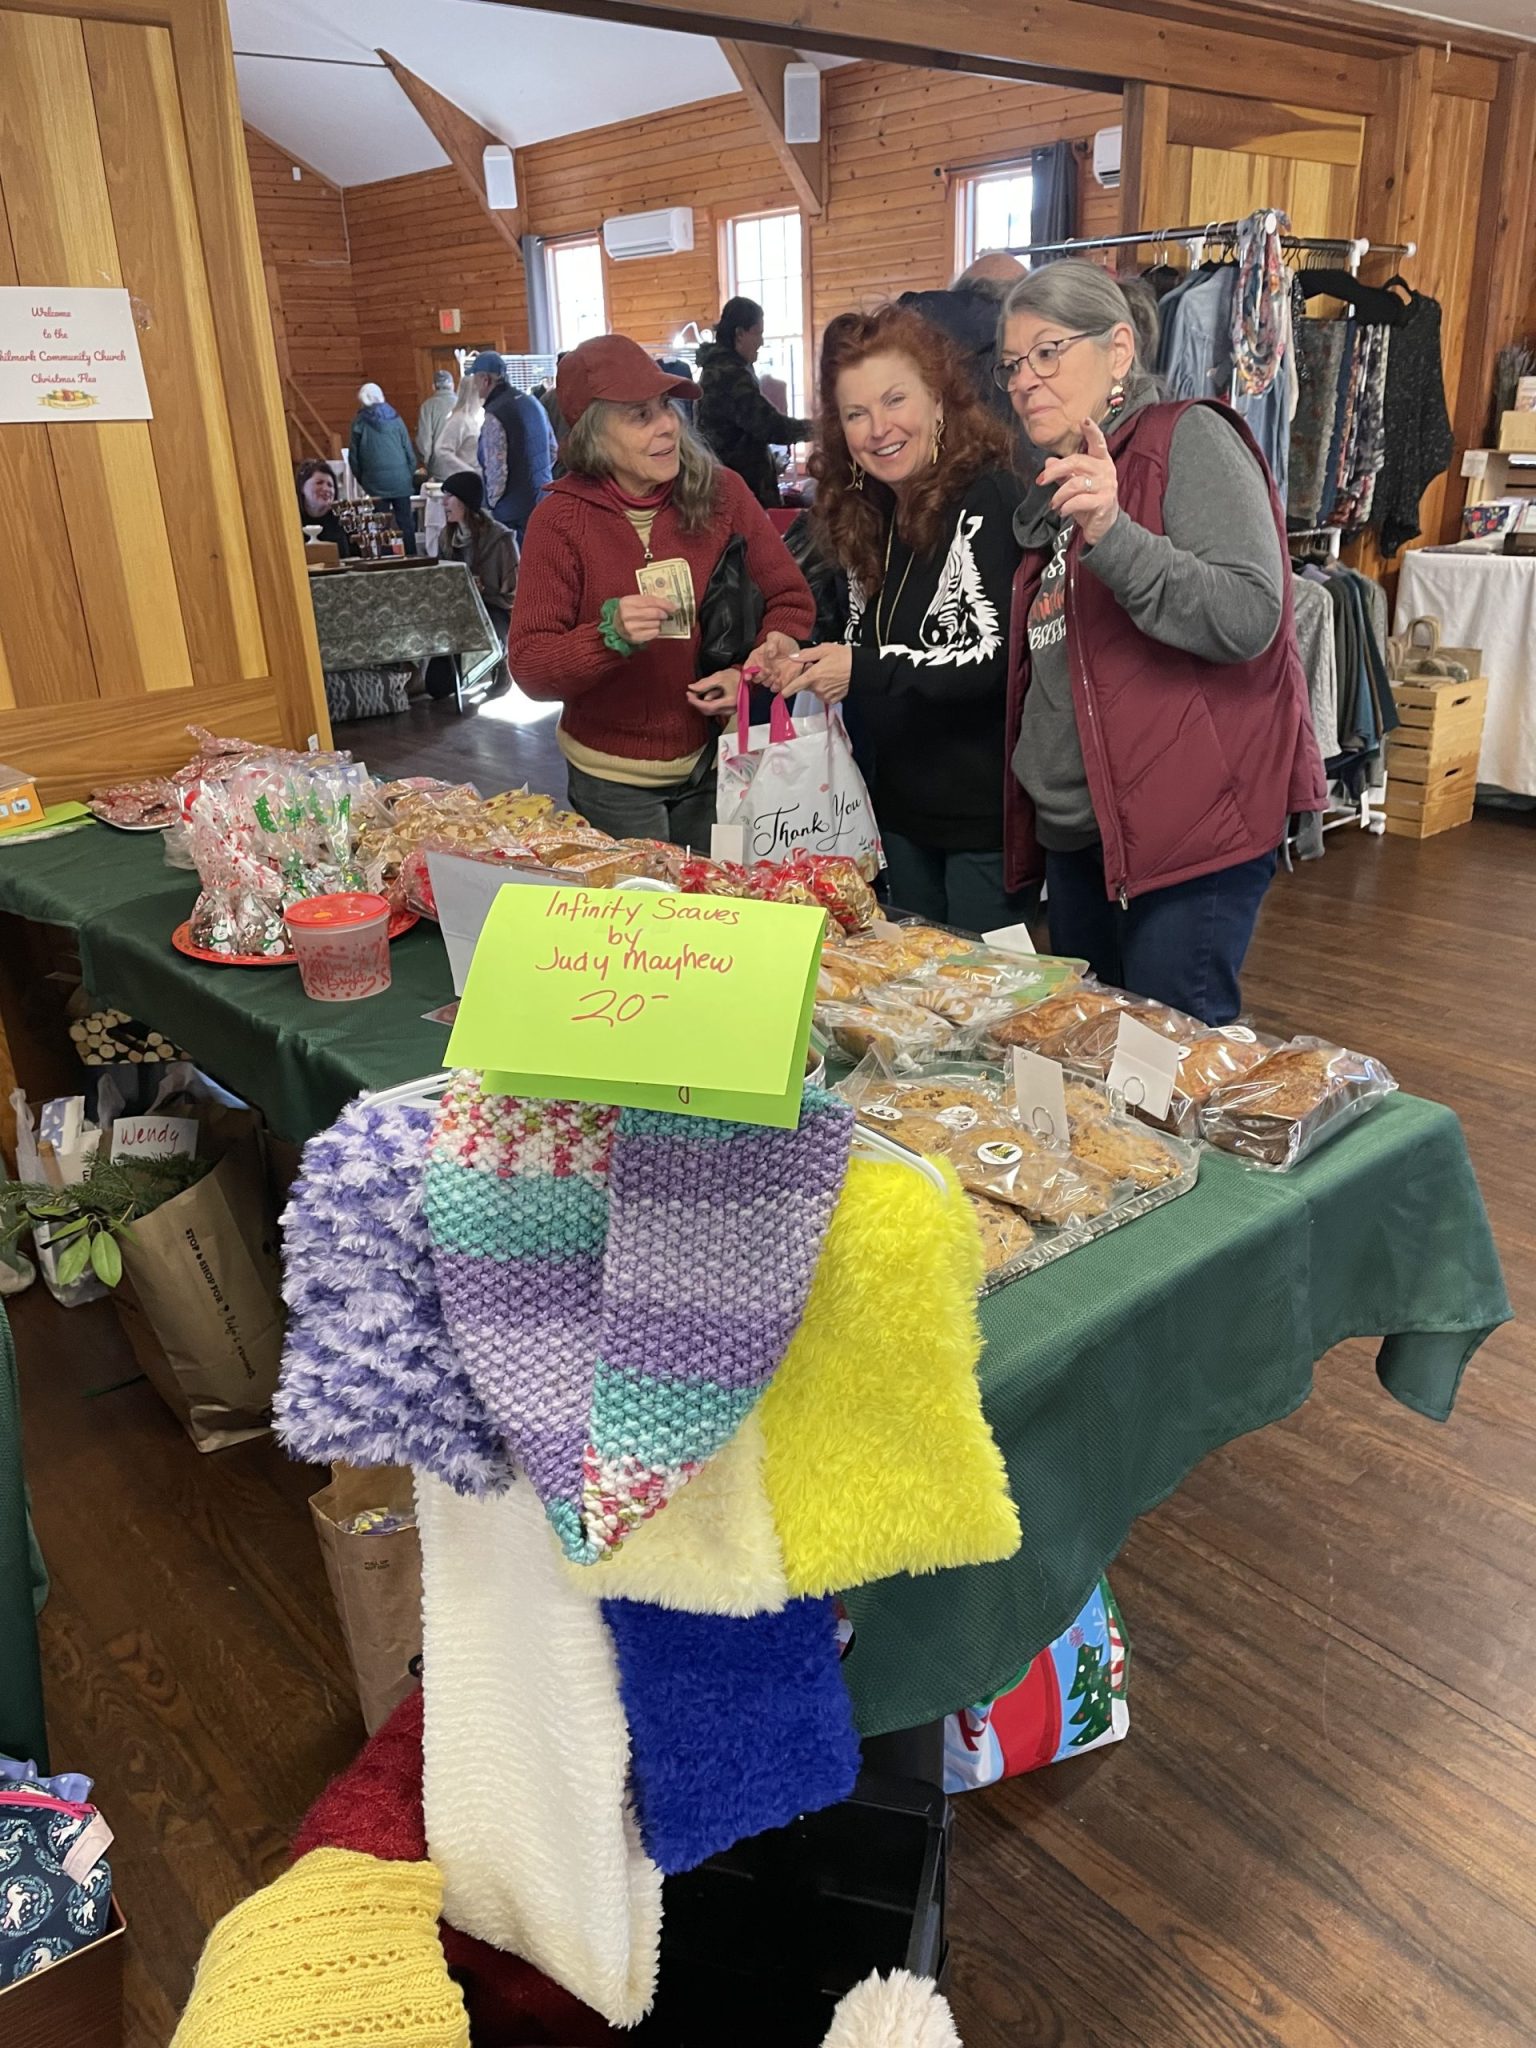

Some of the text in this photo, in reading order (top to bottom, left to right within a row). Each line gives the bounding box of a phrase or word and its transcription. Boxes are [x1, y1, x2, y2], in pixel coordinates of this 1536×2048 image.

[31, 307, 72, 318] Welcome
[43, 328, 69, 339] to the
[39, 350, 91, 366] Community
[94, 350, 126, 362] Church
[31, 372, 97, 384] Christmas Flea
[753, 791, 862, 857] Thank You
[545, 891, 644, 926] Infinity
[607, 924, 644, 951] by
[535, 943, 733, 981] Judy Mayhew
[121, 1122, 179, 1154] Wendy
